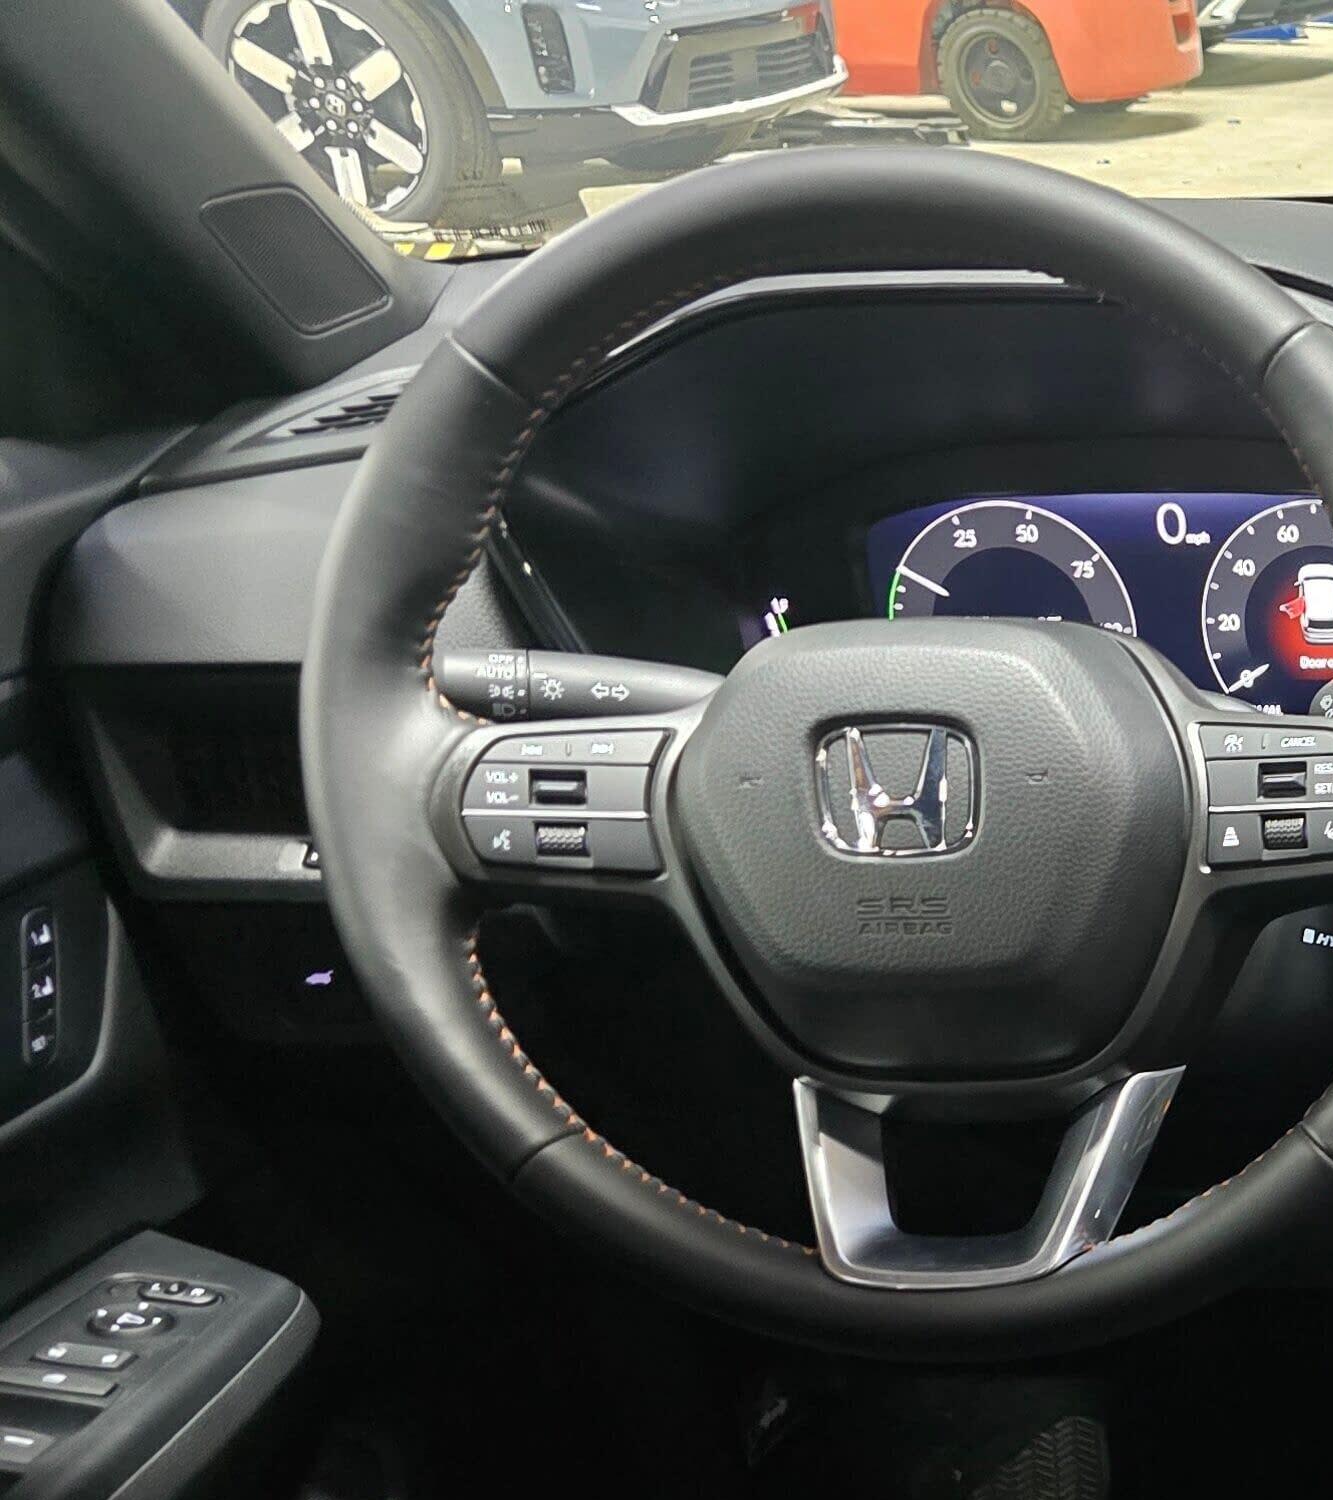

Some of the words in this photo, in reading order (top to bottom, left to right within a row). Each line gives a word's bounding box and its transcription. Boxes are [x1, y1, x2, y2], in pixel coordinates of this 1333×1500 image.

[1015, 523, 1039, 544] 50
[1156, 502, 1187, 545] 0
[1185, 531, 1212, 546] mph
[1276, 524, 1300, 543] 60
[952, 528, 978, 548] 25
[1070, 560, 1095, 579] 75
[1231, 558, 1256, 577] 40
[1217, 613, 1241, 632] 20
[476, 664, 514, 680] AUTO
[1280, 736, 1316, 748] CANCEL
